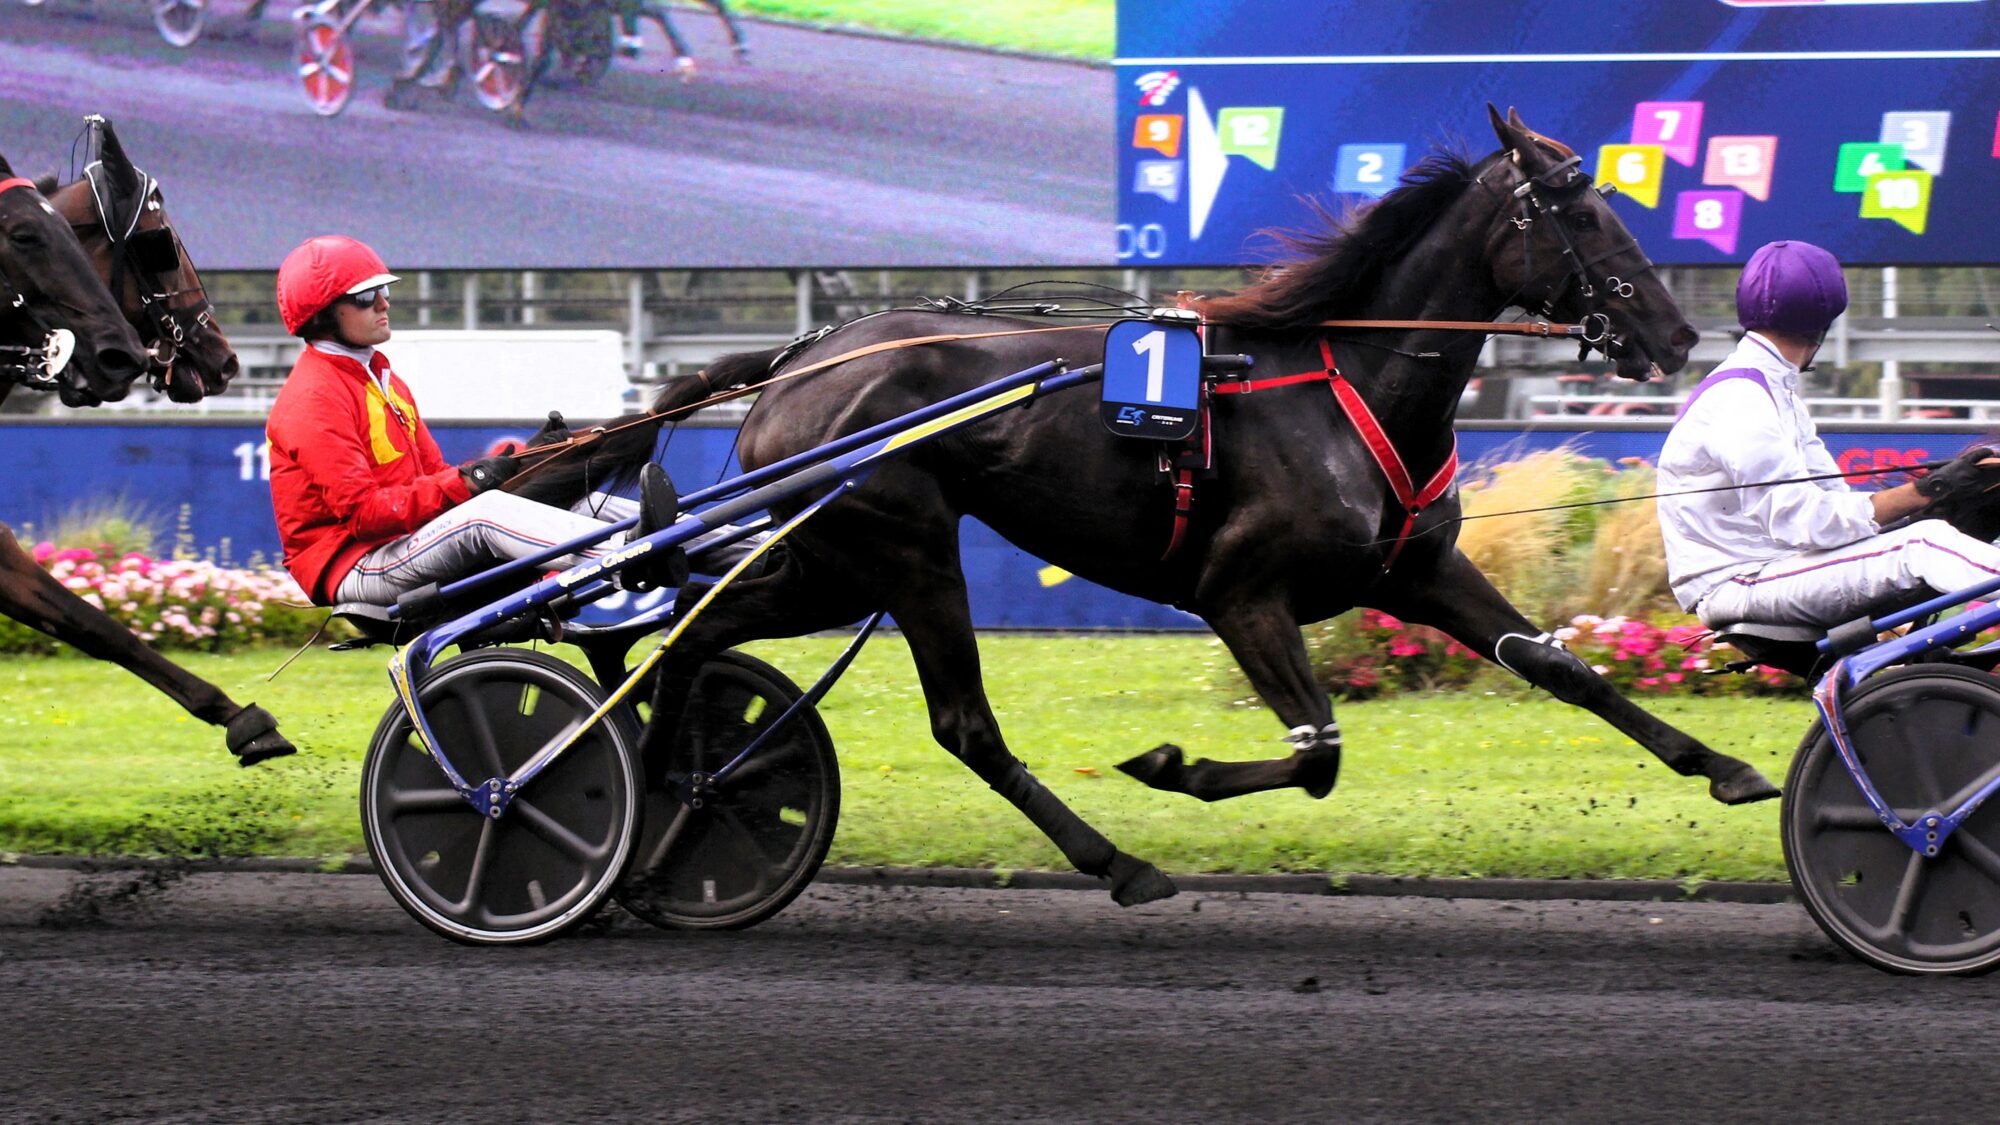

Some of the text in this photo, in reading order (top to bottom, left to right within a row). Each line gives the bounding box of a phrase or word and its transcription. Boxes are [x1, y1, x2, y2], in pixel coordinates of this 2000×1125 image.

[1148, 119, 1171, 142] 9
[1228, 114, 1271, 146] 12
[1653, 109, 1681, 141] 7
[1901, 119, 1929, 150] 3
[1143, 164, 1175, 187] 15
[1356, 152, 1384, 183] 2
[1616, 151, 1646, 184] 6
[1720, 144, 1761, 176] 13
[1874, 178, 1920, 210] 10
[1693, 198, 1724, 230] 8
[1131, 330, 1166, 403] 1
